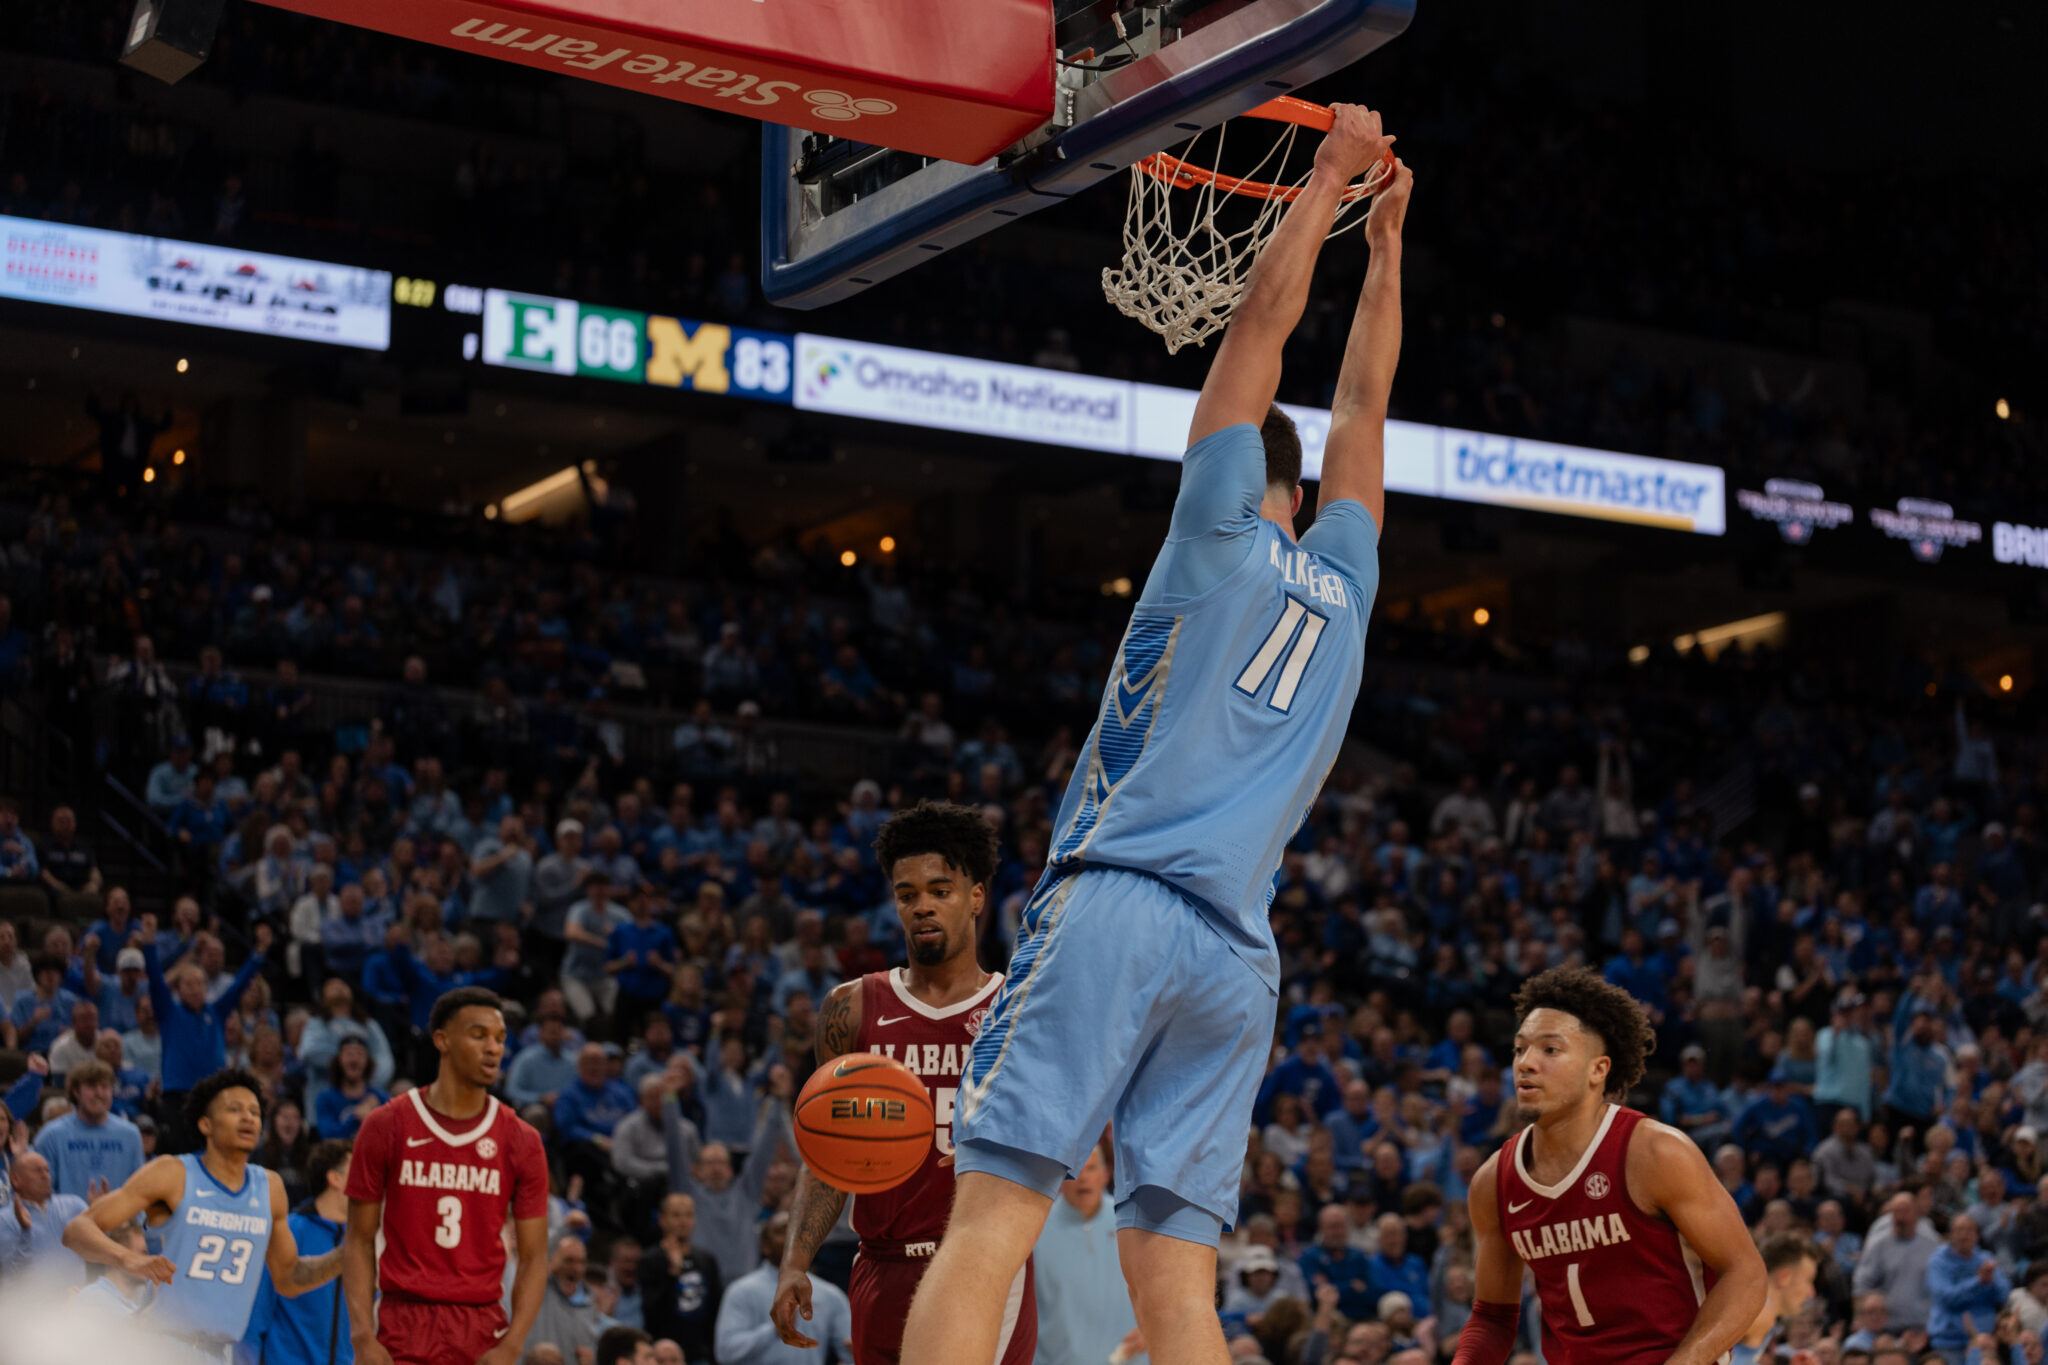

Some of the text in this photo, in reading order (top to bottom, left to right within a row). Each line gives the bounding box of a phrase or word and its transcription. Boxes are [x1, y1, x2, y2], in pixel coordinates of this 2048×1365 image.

[505, 300, 557, 363] E
[578, 315, 638, 372] 66
[646, 314, 731, 394] M
[733, 337, 790, 394] 83
[854, 357, 980, 403] Omaha
[988, 378, 1119, 421] National
[1455, 438, 1709, 513] ticketmaster
[1232, 590, 1330, 715] 11
[831, 1098, 905, 1121] ELITE
[399, 1160, 500, 1195] ALABAMA
[1585, 1173, 1610, 1199] SEC
[186, 1206, 268, 1236] CREIGHTON
[435, 1196, 463, 1249] 3
[1511, 1213, 1631, 1261] ALABAMA
[186, 1234, 255, 1285] 23
[905, 1241, 937, 1257] RTR
[1566, 1263, 1595, 1327] 1
